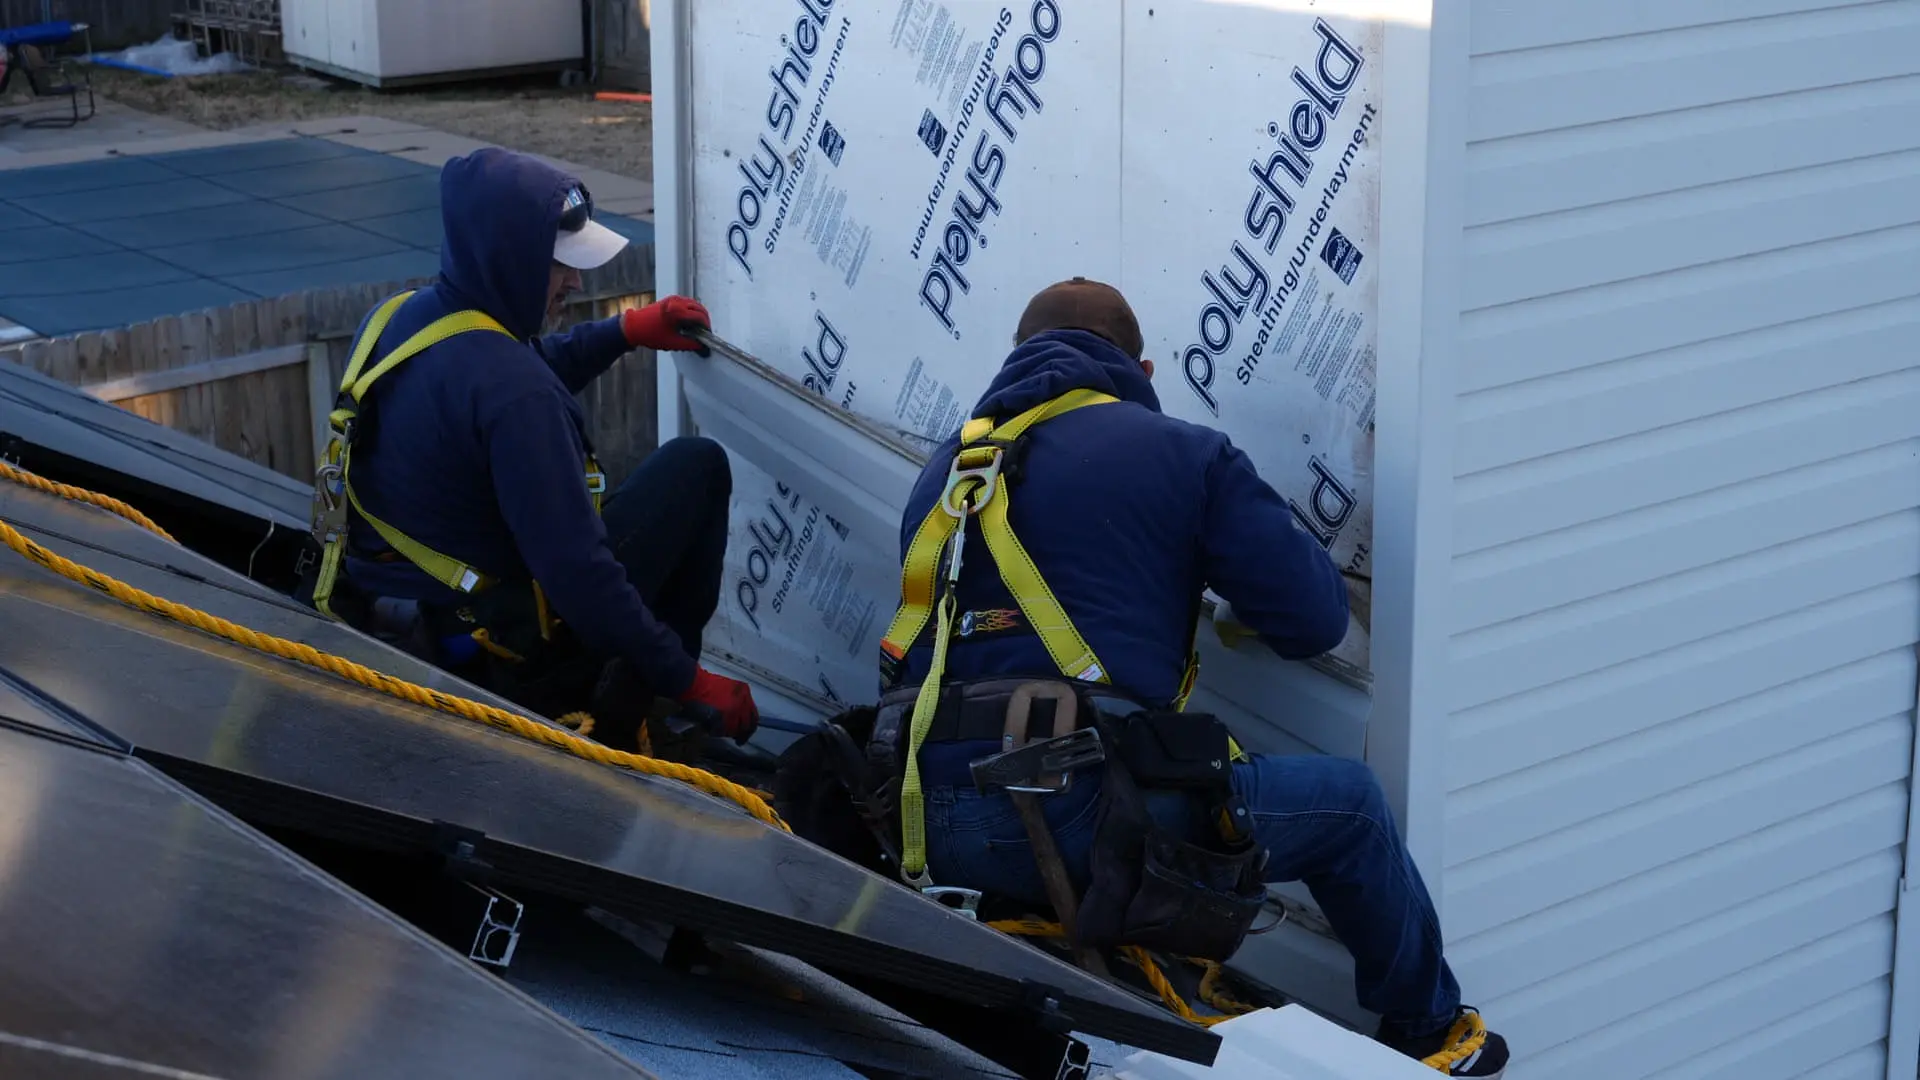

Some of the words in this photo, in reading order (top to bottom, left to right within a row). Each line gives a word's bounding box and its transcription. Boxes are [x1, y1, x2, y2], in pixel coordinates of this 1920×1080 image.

[726, 133, 787, 282] poly
[766, 0, 836, 145] shiel
[765, 17, 851, 254] Sheathing/Underlayment
[910, 7, 1012, 260] Sheathing/Underlayment
[919, 129, 1006, 335] shield
[1182, 240, 1272, 418] poly
[1244, 16, 1365, 256] shield
[1237, 103, 1377, 385] Sheathing/Underlayment
[738, 497, 794, 638] poly
